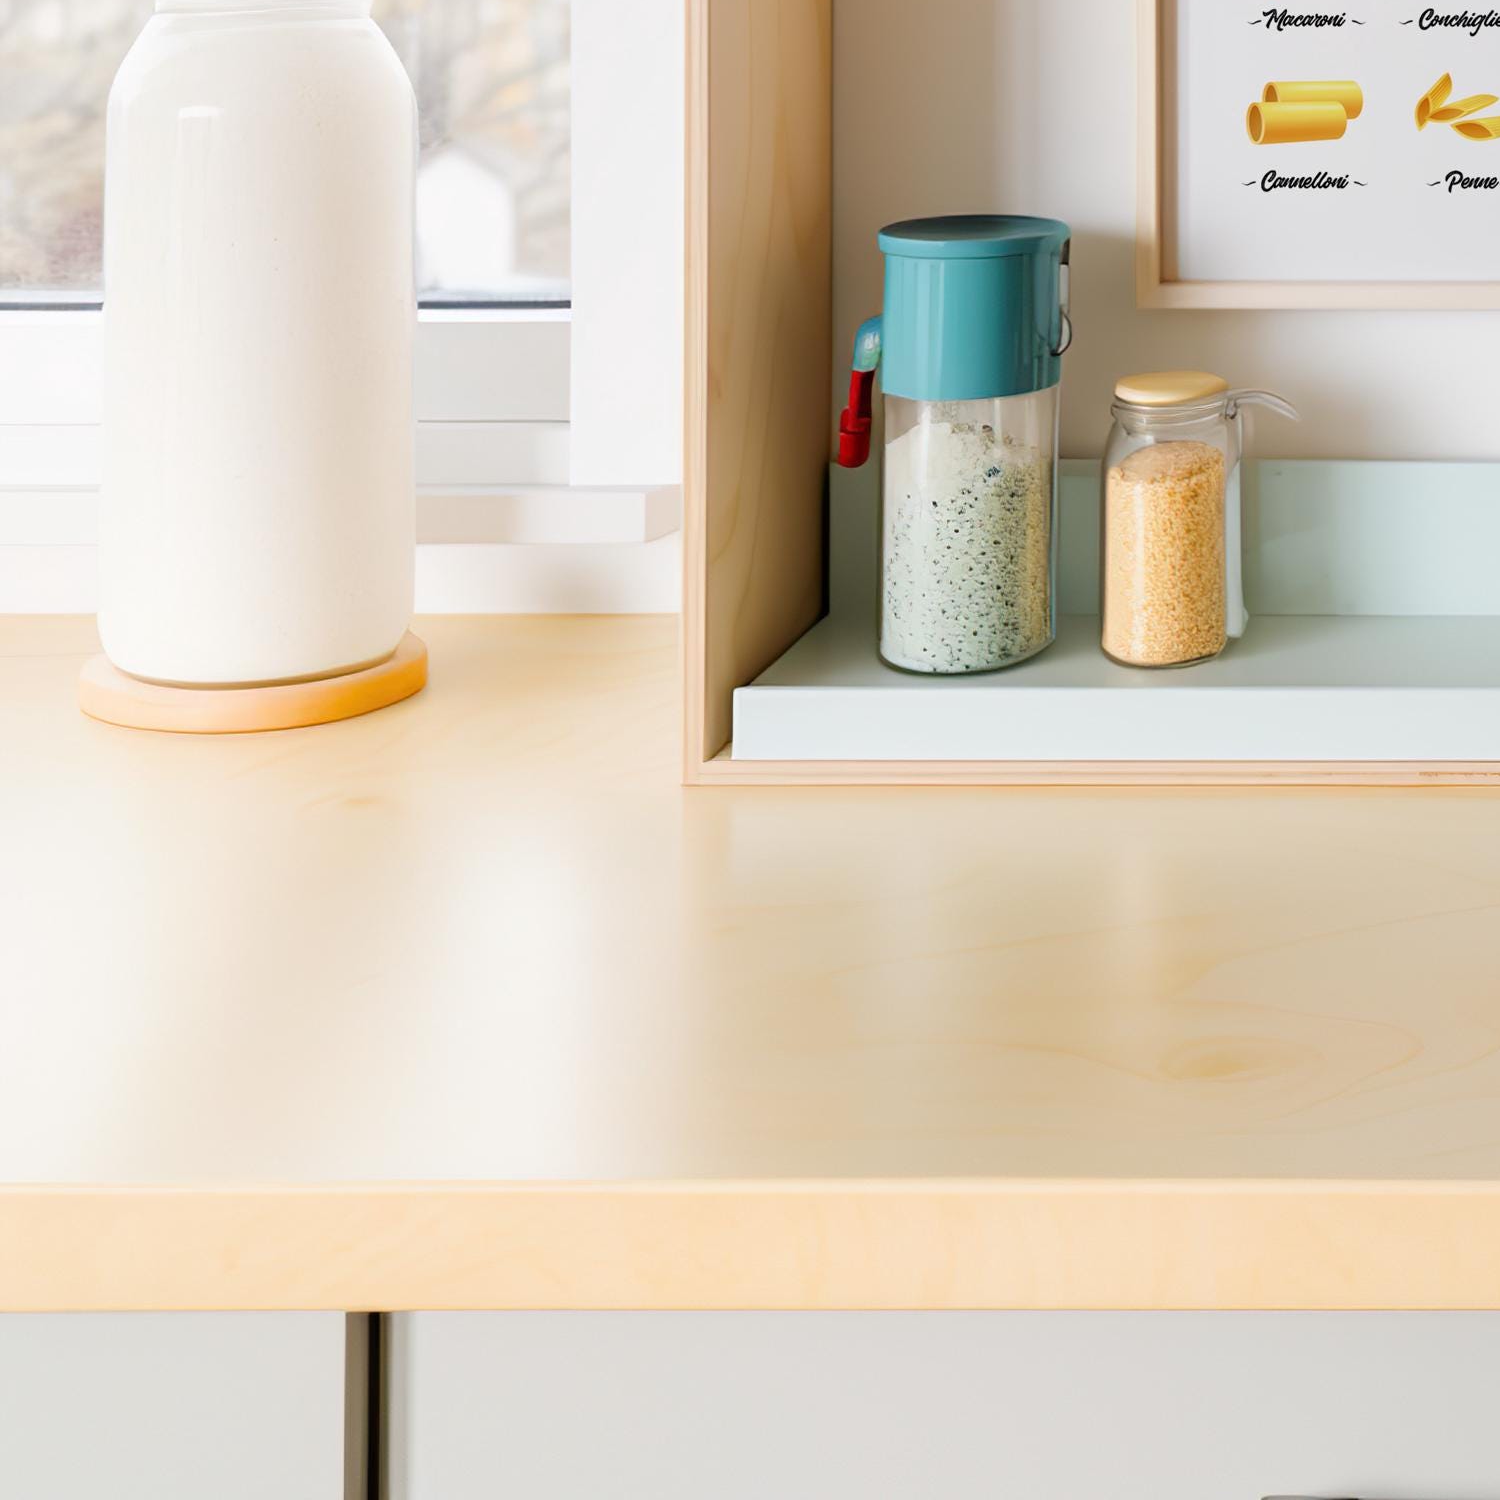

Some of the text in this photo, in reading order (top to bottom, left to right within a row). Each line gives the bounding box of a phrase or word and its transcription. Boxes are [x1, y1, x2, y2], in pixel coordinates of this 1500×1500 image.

[1262, 8, 1346, 32] Macaroni
[1260, 169, 1350, 193] Cannelloni
[1444, 169, 1500, 194] Penne
